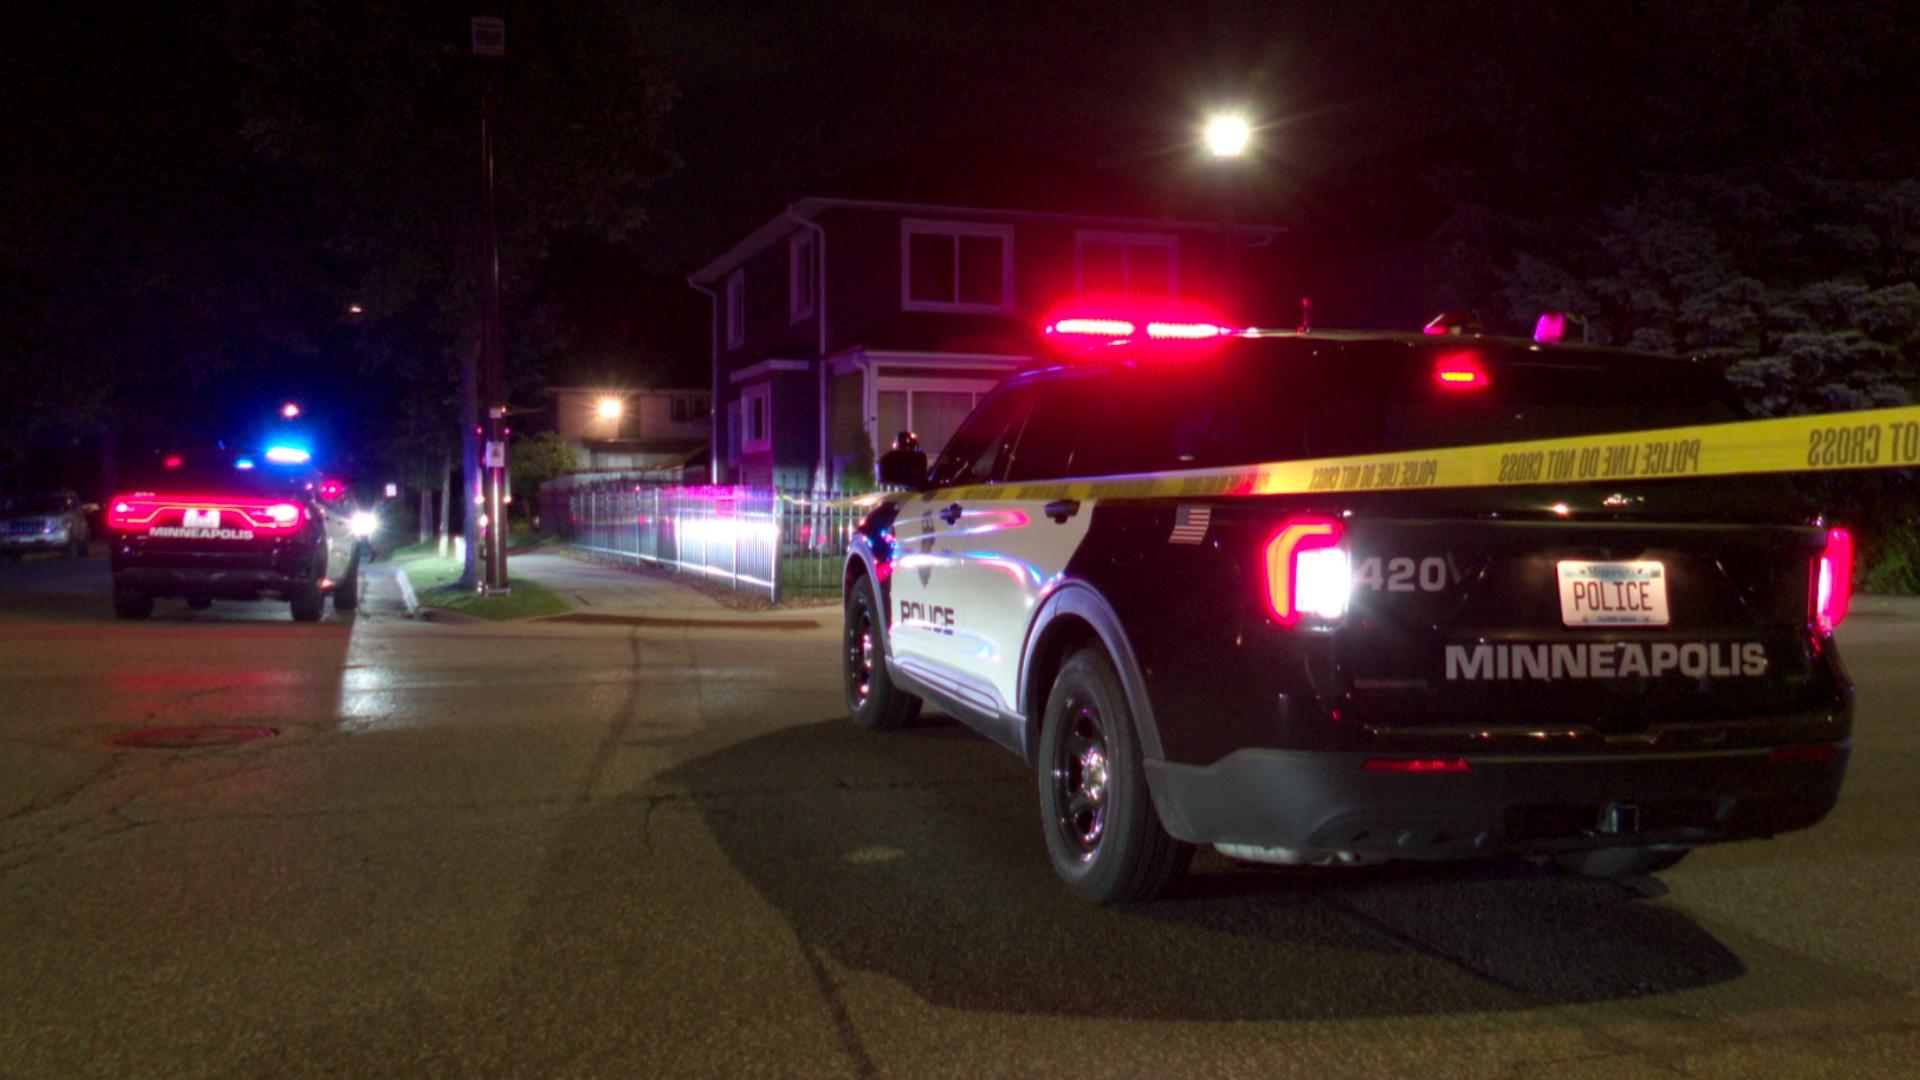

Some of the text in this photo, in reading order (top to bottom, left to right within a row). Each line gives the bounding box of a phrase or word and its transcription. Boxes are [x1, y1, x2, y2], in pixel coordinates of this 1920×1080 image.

[149, 526, 254, 541] MINNEAPOLIS
[1355, 556, 1447, 592] 420
[1573, 580, 1654, 611] POLICE
[900, 600, 955, 636] POLICE
[1445, 642, 1768, 681] MINNEAPOLIS
